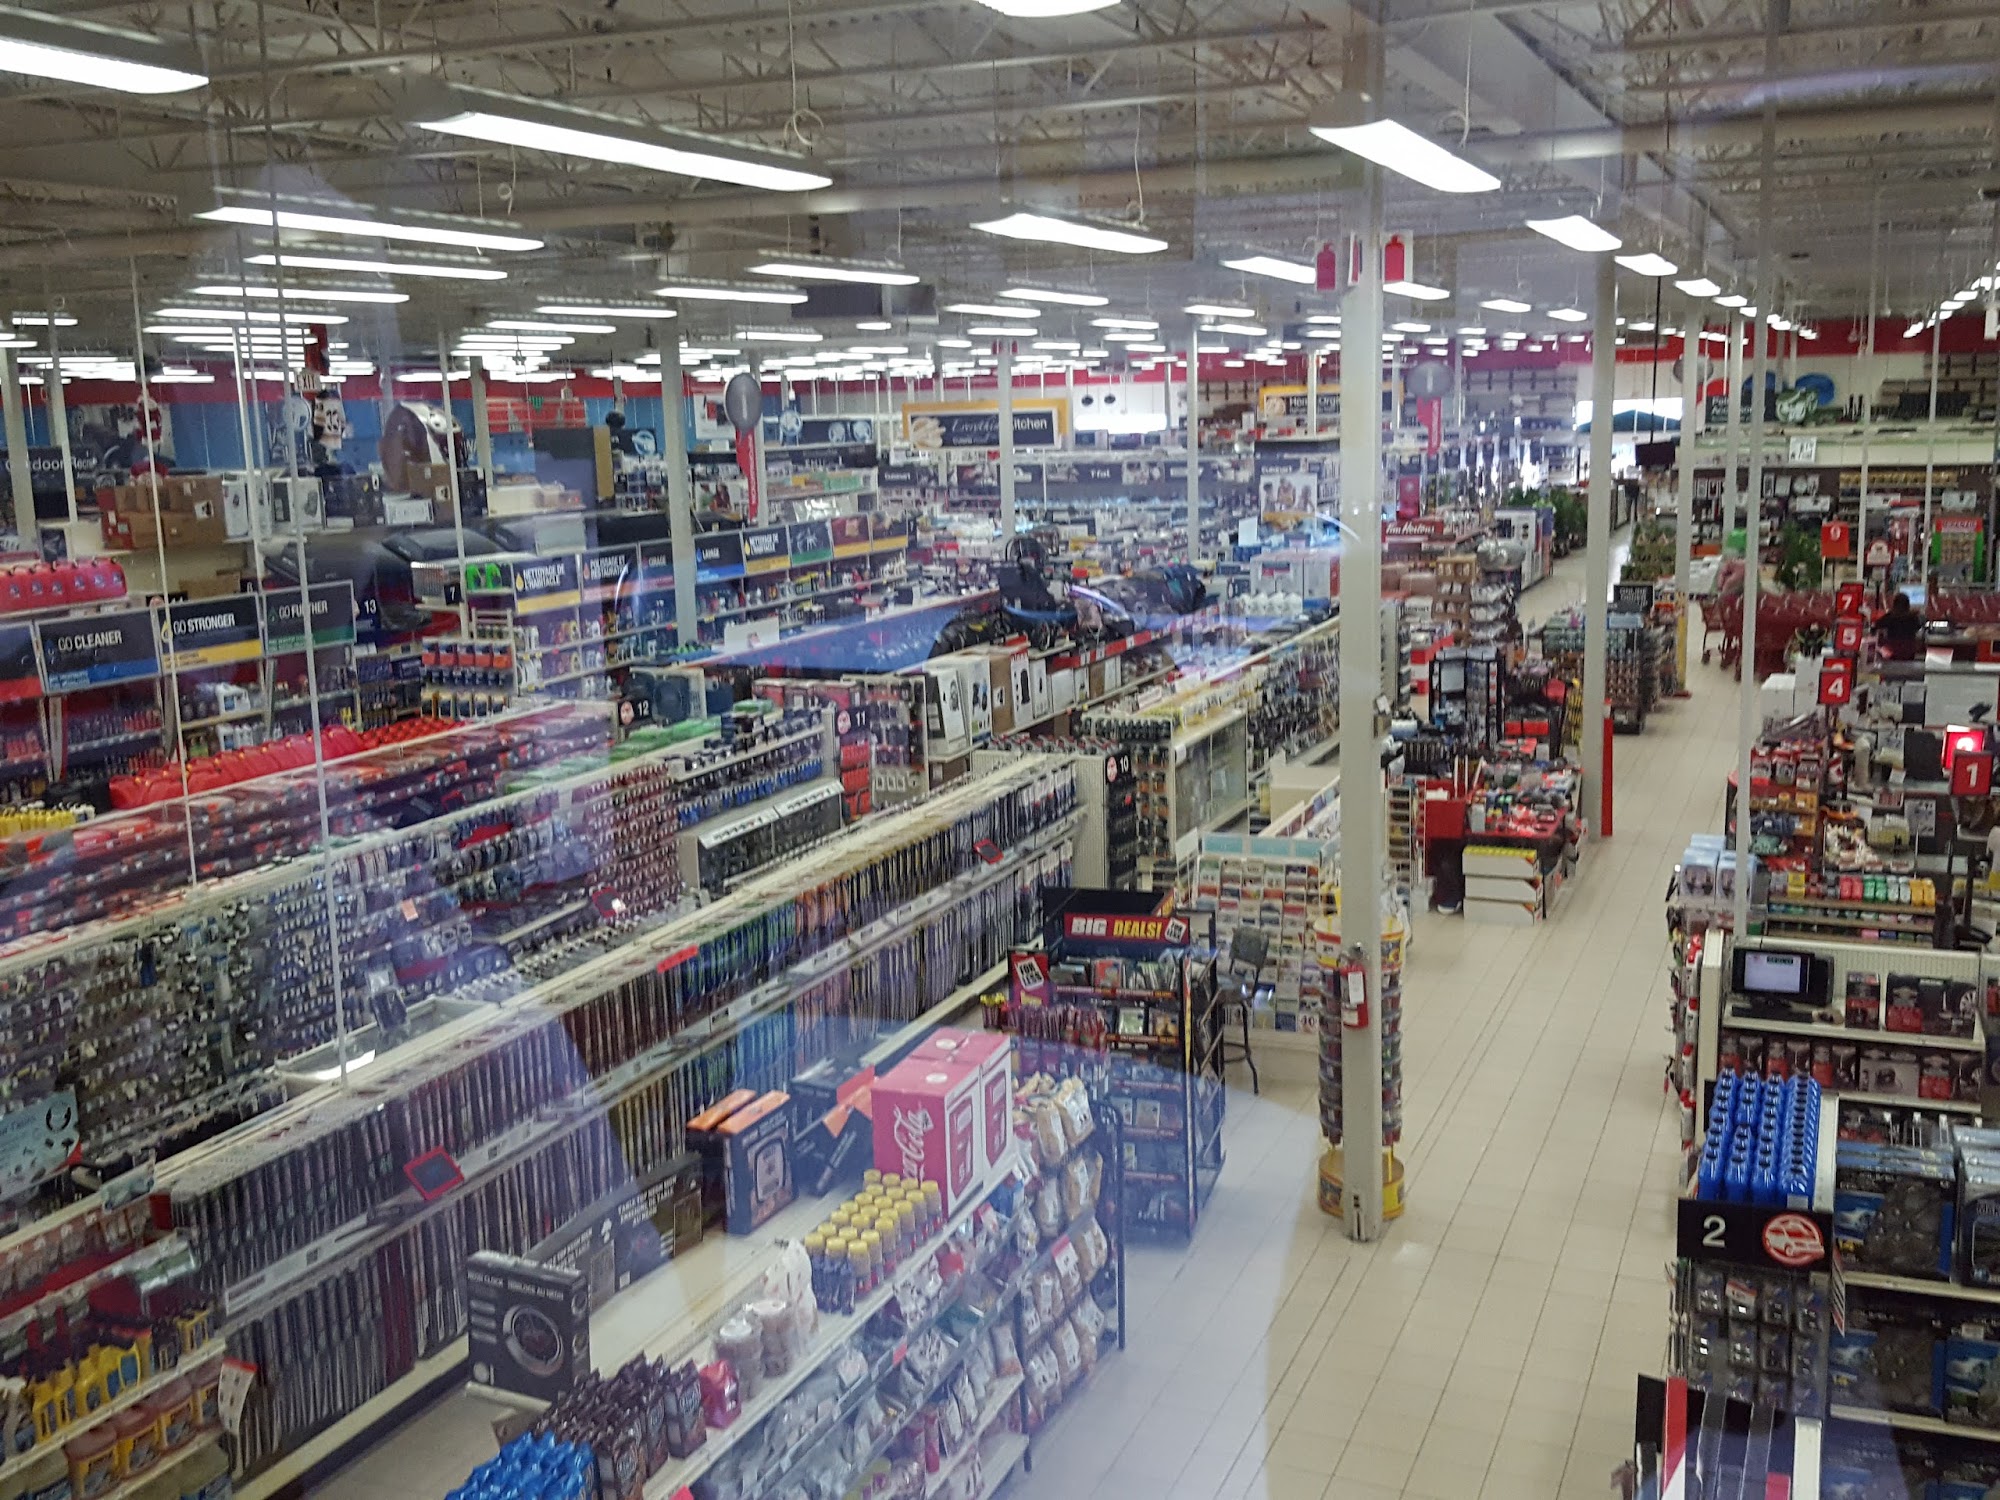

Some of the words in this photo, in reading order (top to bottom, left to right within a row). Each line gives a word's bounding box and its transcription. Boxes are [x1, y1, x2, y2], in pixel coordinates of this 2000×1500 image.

[1012, 415, 1048, 431] itchen
[523, 564, 556, 582] NETTOYAGE
[556, 562, 565, 576] DE
[449, 585, 456, 600] 7
[291, 599, 329, 618] FUHER
[364, 598, 377, 615] 13
[1841, 594, 1853, 611] 7
[173, 619, 187, 635] GO
[187, 612, 236, 633] STRONGER
[57, 636, 73, 651] GO
[74, 629, 123, 650] CLEANER
[1827, 677, 1844, 698] 4
[638, 700, 649, 716] 12
[855, 711, 866, 726] 11
[1964, 762, 1980, 788] 1
[1071, 916, 1107, 937] BIG
[1112, 919, 1163, 940] DEALS!
[1702, 1215, 1727, 1248] 2
